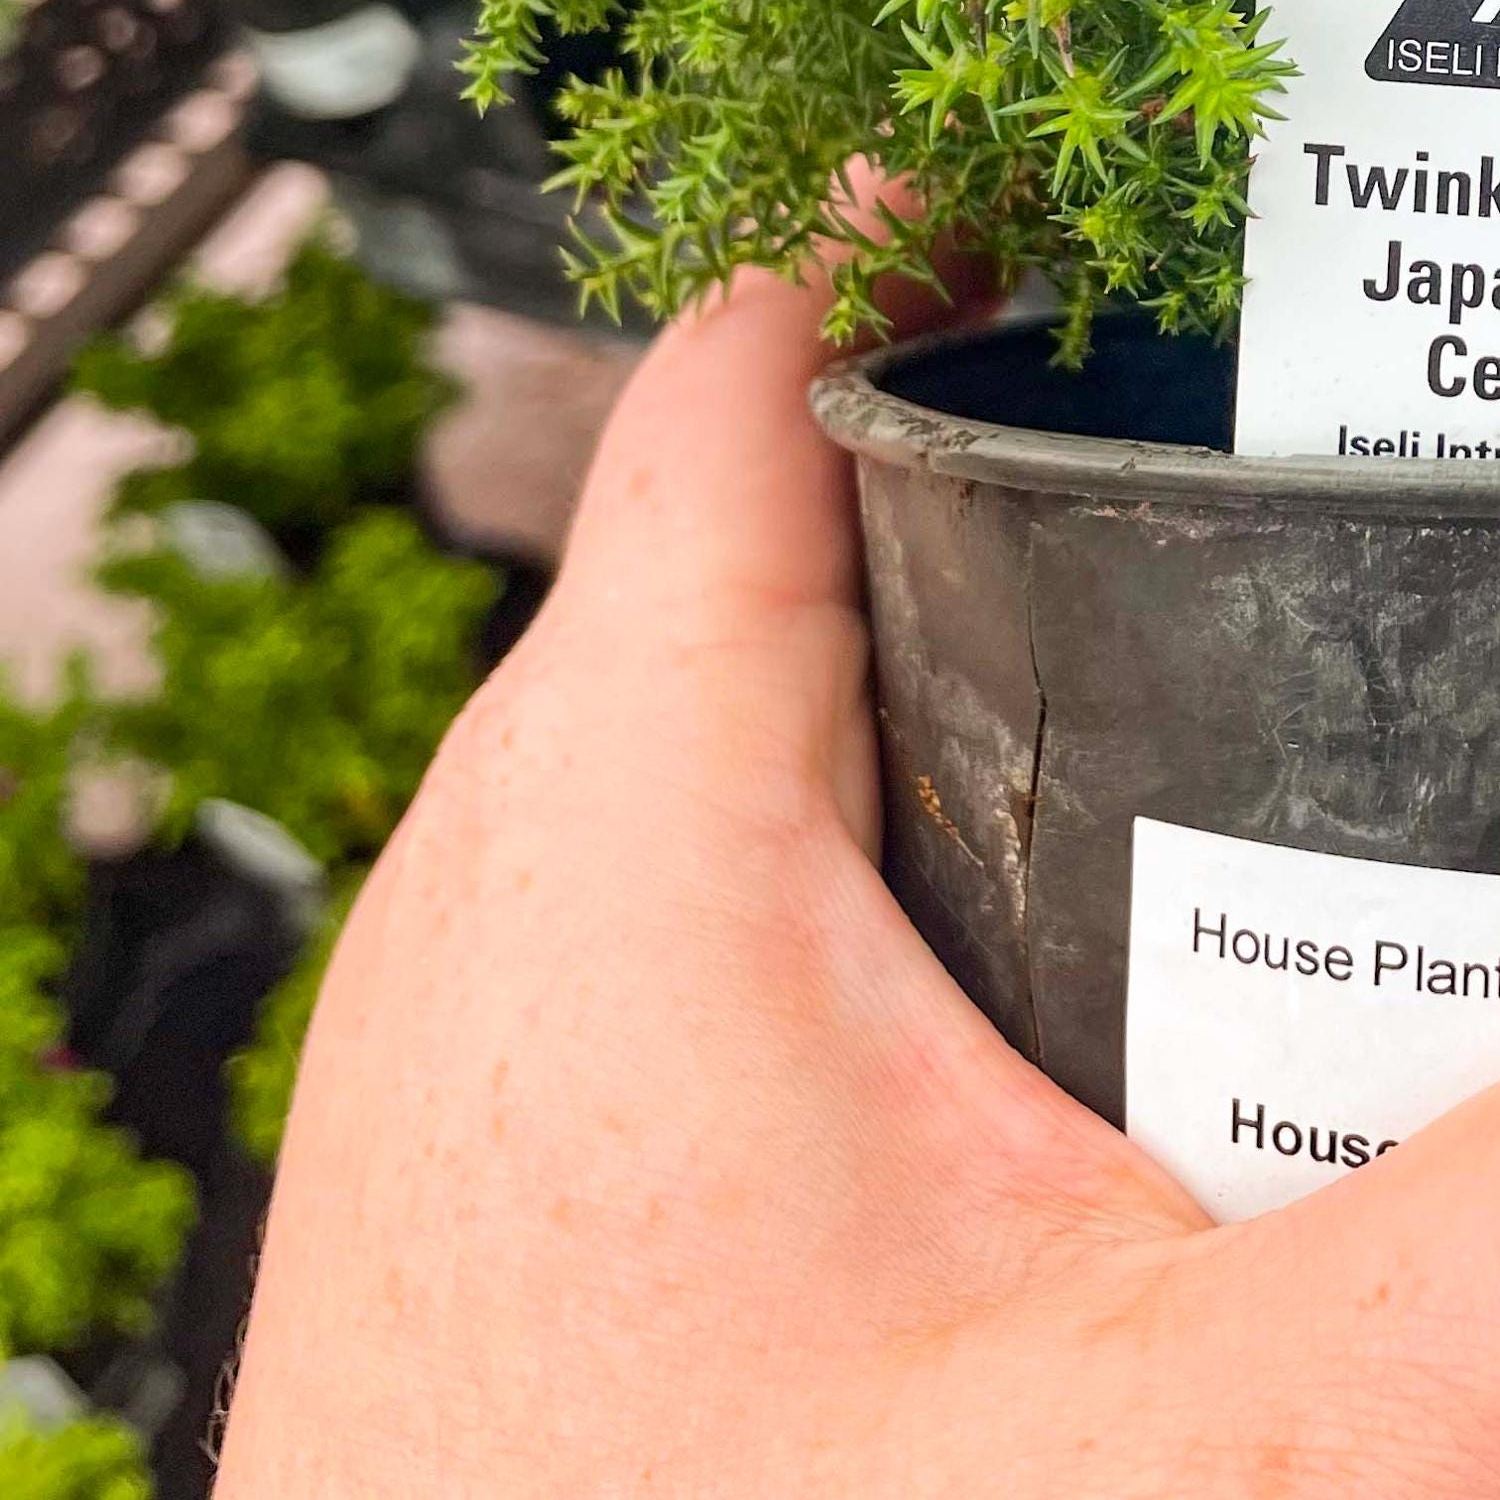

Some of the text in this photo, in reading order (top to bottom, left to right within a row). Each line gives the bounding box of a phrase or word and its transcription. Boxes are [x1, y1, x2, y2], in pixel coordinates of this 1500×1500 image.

[1387, 39, 1483, 77] ISELI
[1337, 425, 1421, 459] Iseli
[1193, 907, 1354, 981] House
[1231, 1098, 1399, 1169] Hous
